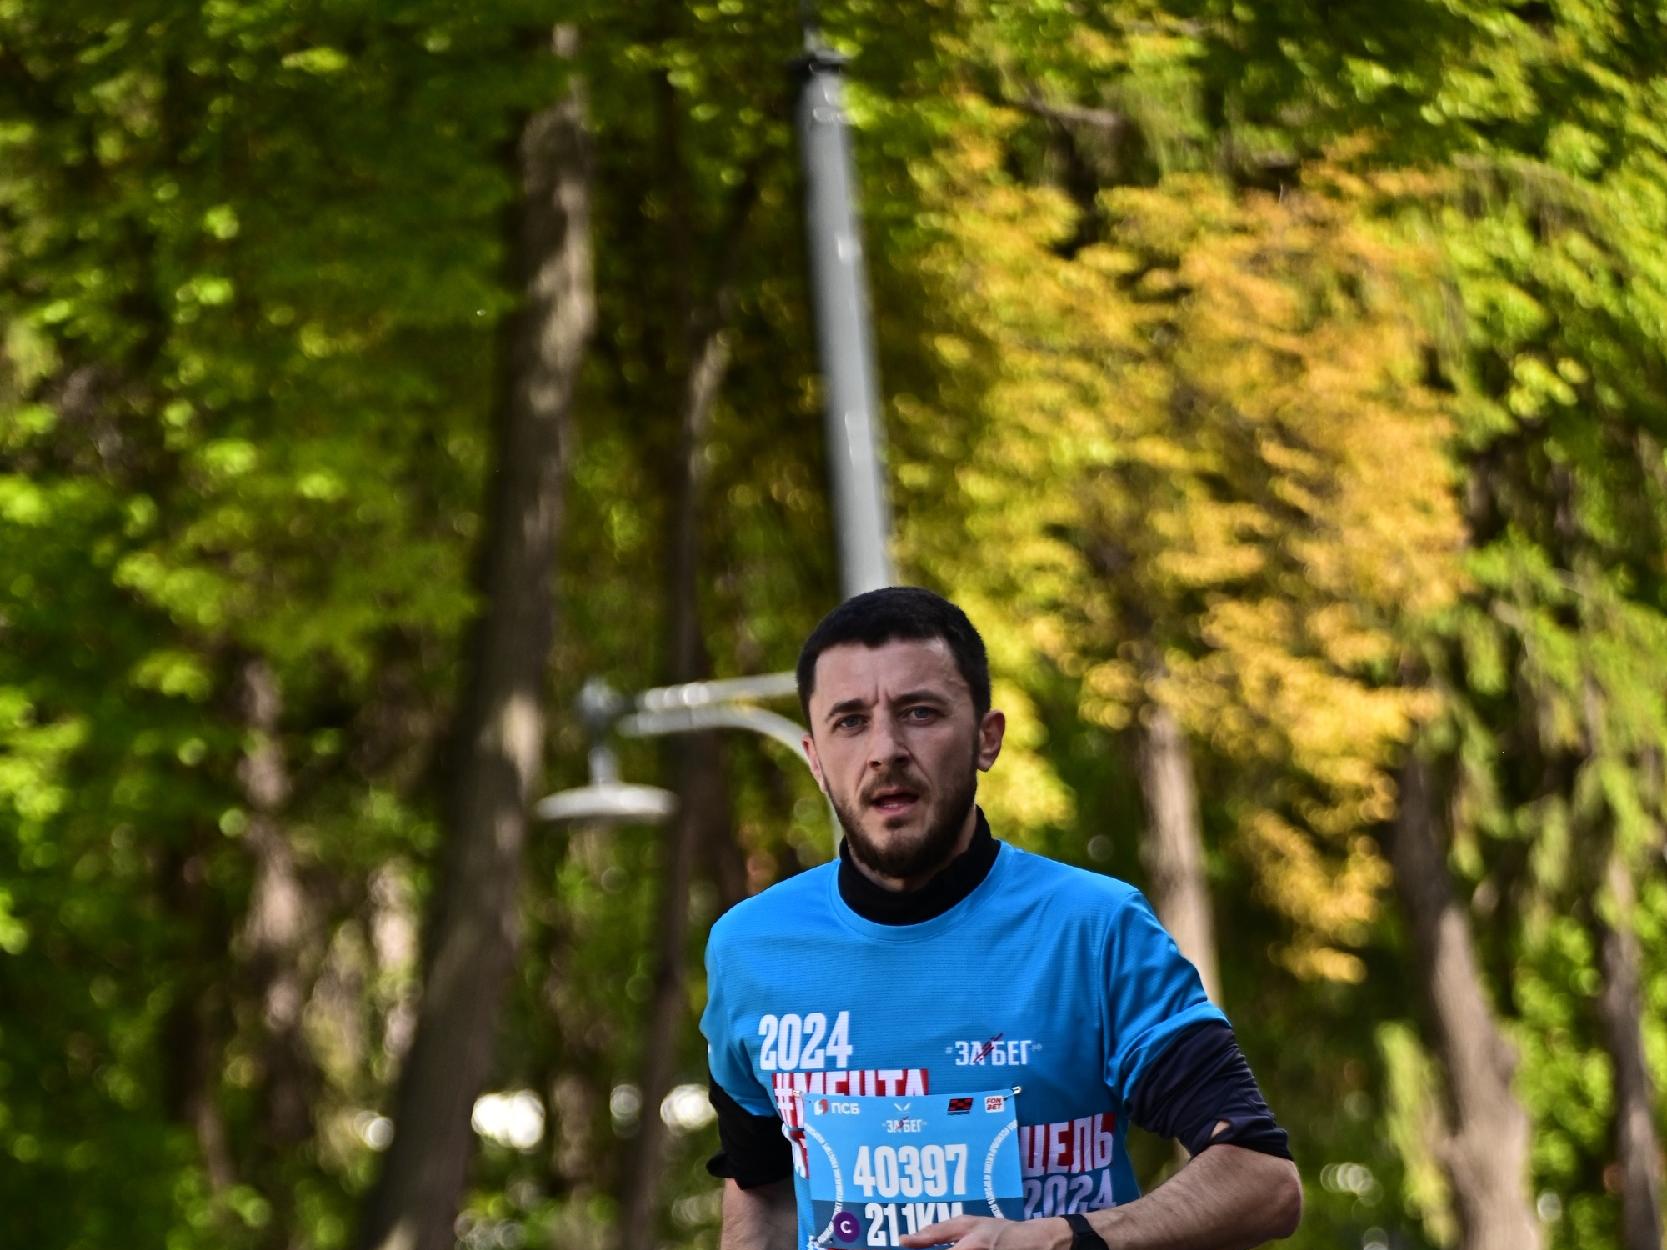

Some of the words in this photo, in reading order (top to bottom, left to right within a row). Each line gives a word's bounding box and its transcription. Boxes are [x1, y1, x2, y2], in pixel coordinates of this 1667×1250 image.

[758, 1011, 853, 1070] 2024
[832, 1103, 860, 1114] ПСБ
[853, 1144, 967, 1198] 40397
